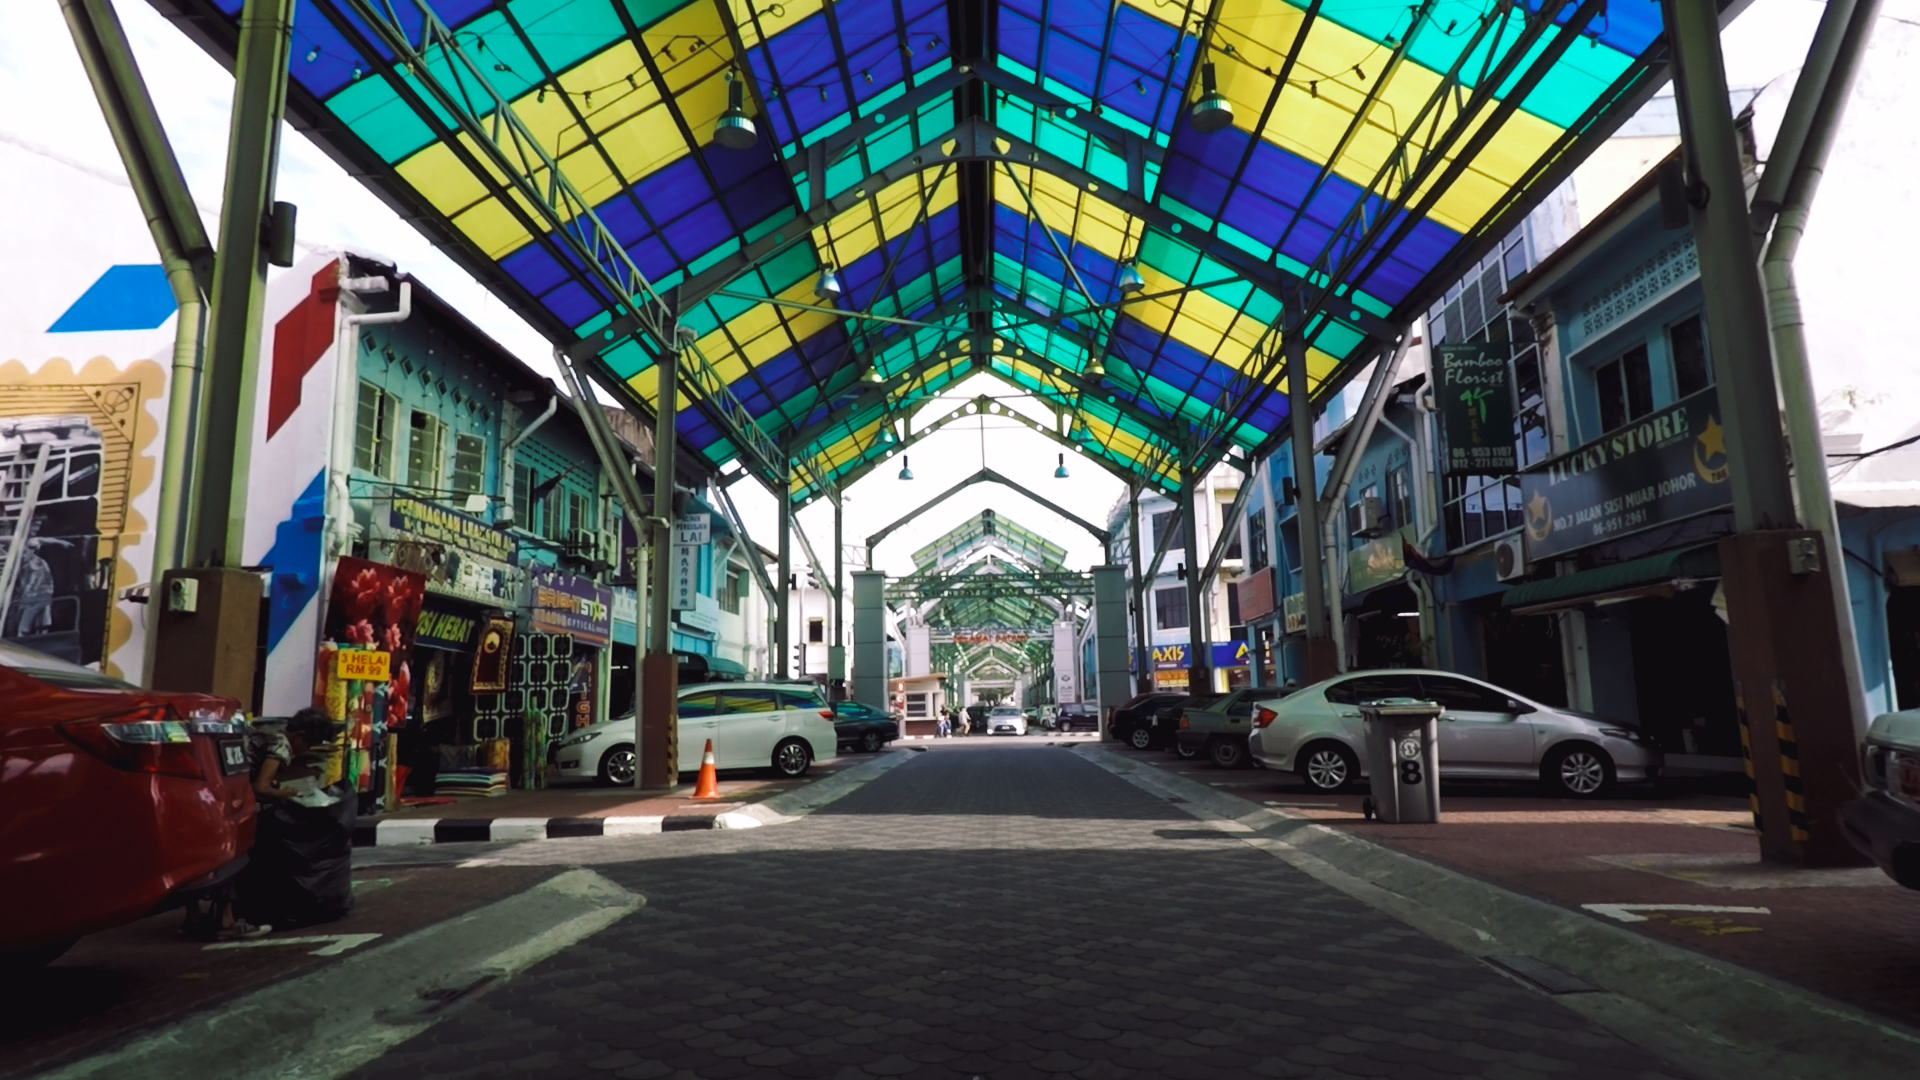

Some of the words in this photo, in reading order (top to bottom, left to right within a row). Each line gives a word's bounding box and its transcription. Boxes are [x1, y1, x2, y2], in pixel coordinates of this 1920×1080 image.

[1443, 351, 1503, 369] Bamboo
[1445, 368, 1503, 386] Florist
[1549, 441, 1609, 487] LUCKY
[1611, 407, 1689, 460] STORE
[1553, 514, 1574, 532] NO.7
[1575, 503, 1602, 526] JALAN
[1603, 496, 1625, 517] SISI
[1626, 487, 1656, 510] MUAR
[1658, 472, 1697, 499] JOHOR
[1592, 518, 1623, 537] 06-951
[1624, 509, 1648, 528] 2961
[680, 531, 703, 543] LAI
[432, 613, 475, 643] HEBAT
[567, 616, 596, 633] OPTICAL
[341, 653, 348, 663] 3
[352, 654, 387, 665] HELAI
[1152, 646, 1185, 662] AXIS
[346, 665, 365, 674] RM
[368, 666, 381, 676] 99
[1401, 760, 1422, 785] 8
